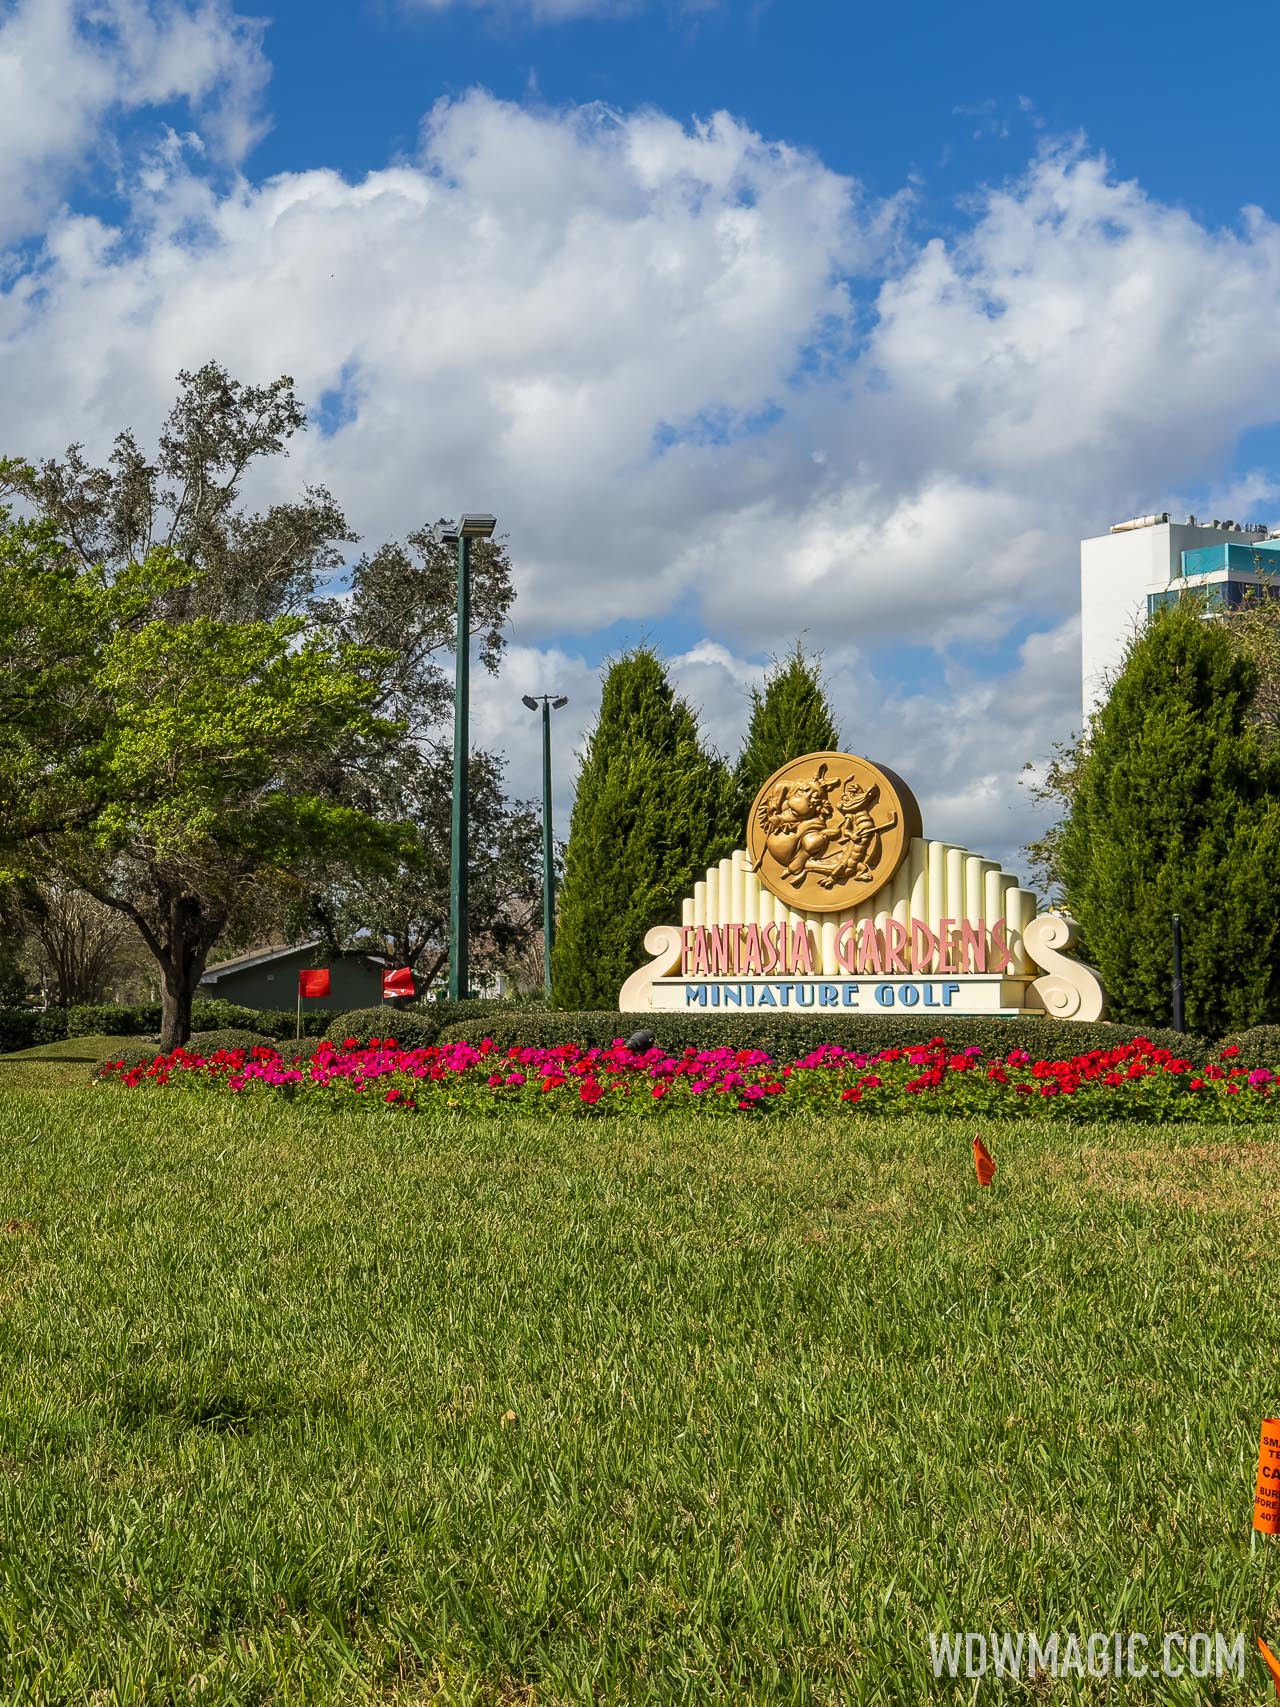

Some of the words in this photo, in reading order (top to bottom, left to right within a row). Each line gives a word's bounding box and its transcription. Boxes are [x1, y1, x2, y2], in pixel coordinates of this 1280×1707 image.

[681, 920, 814, 975] FANTASIA
[833, 917, 1013, 974] GARDENS
[685, 983, 860, 1007] MINIATURE
[874, 982, 960, 1007] GOLF
[1263, 1436, 1280, 1449] SM
